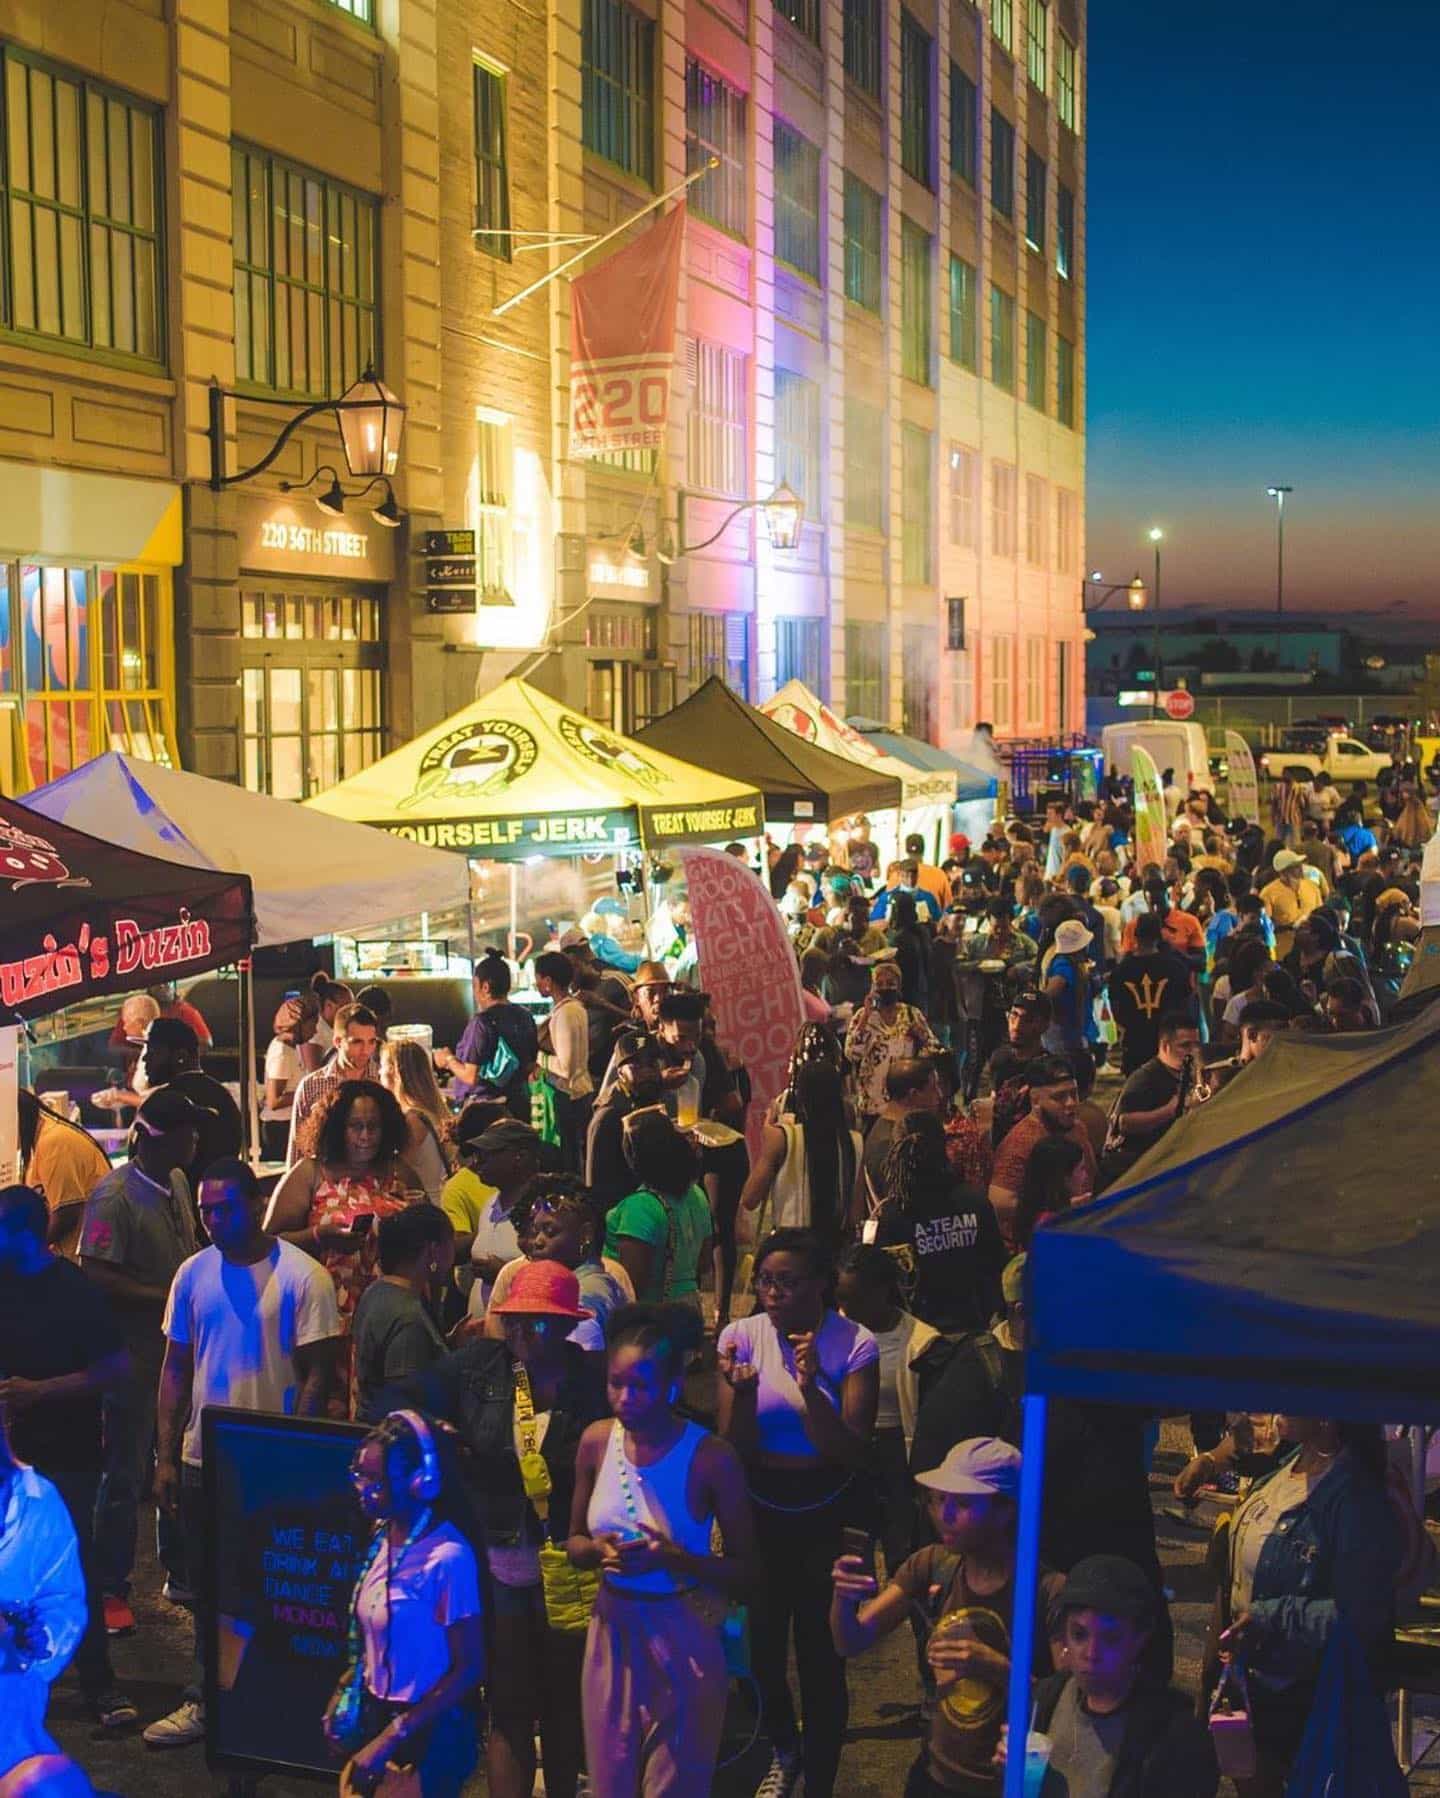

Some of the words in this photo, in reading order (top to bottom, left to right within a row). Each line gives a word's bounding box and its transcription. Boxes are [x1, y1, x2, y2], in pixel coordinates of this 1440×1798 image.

[574, 376, 669, 432] 220
[611, 431, 664, 448] STREE
[262, 522, 287, 549] 220
[323, 530, 368, 558] STREET
[1167, 697, 1193, 711] STOP
[422, 725, 474, 770] TREAT
[481, 721, 536, 775] YOURSELF
[531, 815, 609, 842] JERK
[651, 811, 685, 836] TREAT
[685, 808, 732, 833] YOURSELF
[732, 806, 757, 828] JERK
[0, 921, 110, 1008] uzin's
[115, 907, 212, 975] Duzin
[915, 1213, 977, 1238] A-TEAM
[917, 1229, 978, 1255] SECURITY
[272, 1527, 305, 1551] WE
